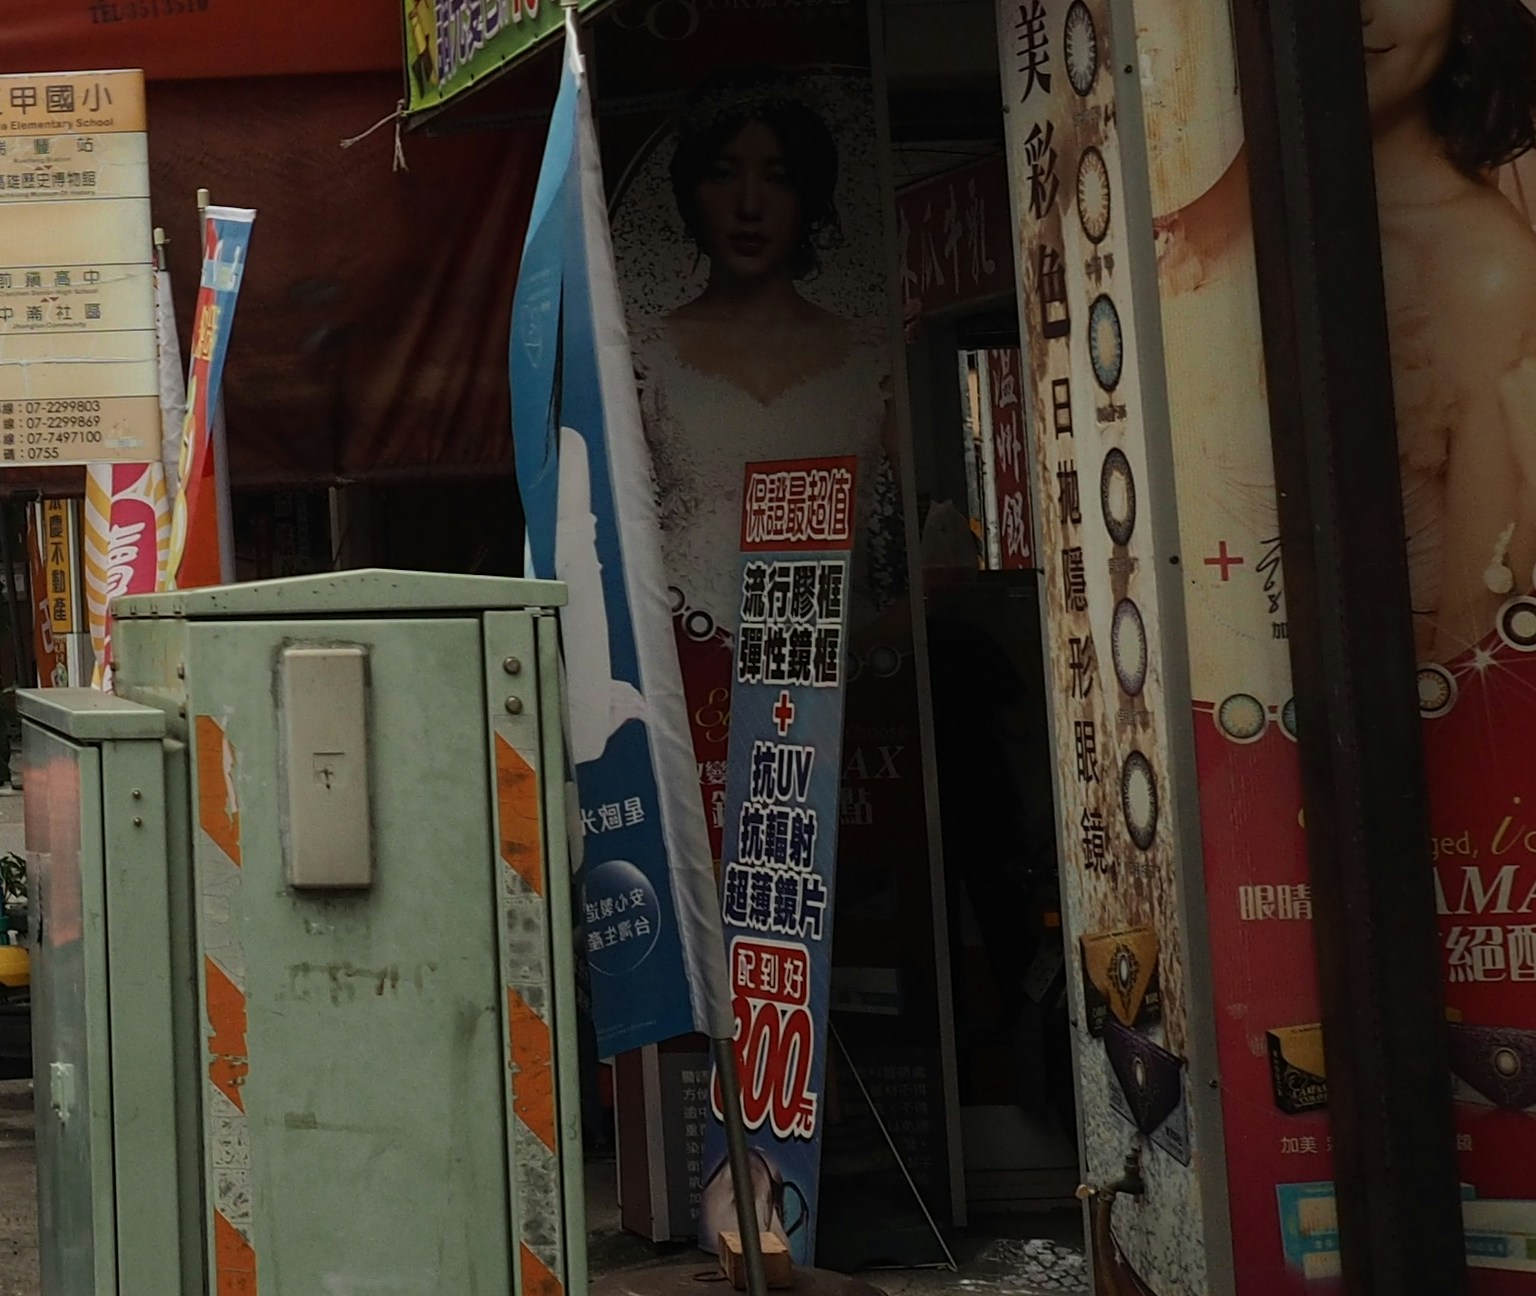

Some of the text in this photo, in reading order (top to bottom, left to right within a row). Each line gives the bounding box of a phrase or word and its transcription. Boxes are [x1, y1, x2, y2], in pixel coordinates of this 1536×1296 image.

[10, 120, 72, 129] Elementary
[76, 118, 113, 128] School
[26, 401, 101, 414] 07-2299803
[27, 416, 101, 429] 07-2299869
[28, 431, 102, 445] 07-7497100
[28, 447, 60, 460] 0755
[745, 467, 851, 541] 保證最超值
[1052, 378, 1110, 876] 日拋隱形眼鏡
[753, 741, 813, 804] 抗UV
[738, 800, 816, 872] 抗輻射
[724, 866, 826, 941] 超薄鏡片
[736, 947, 808, 997] 配到好
[794, 1098, 815, 1138] 元
